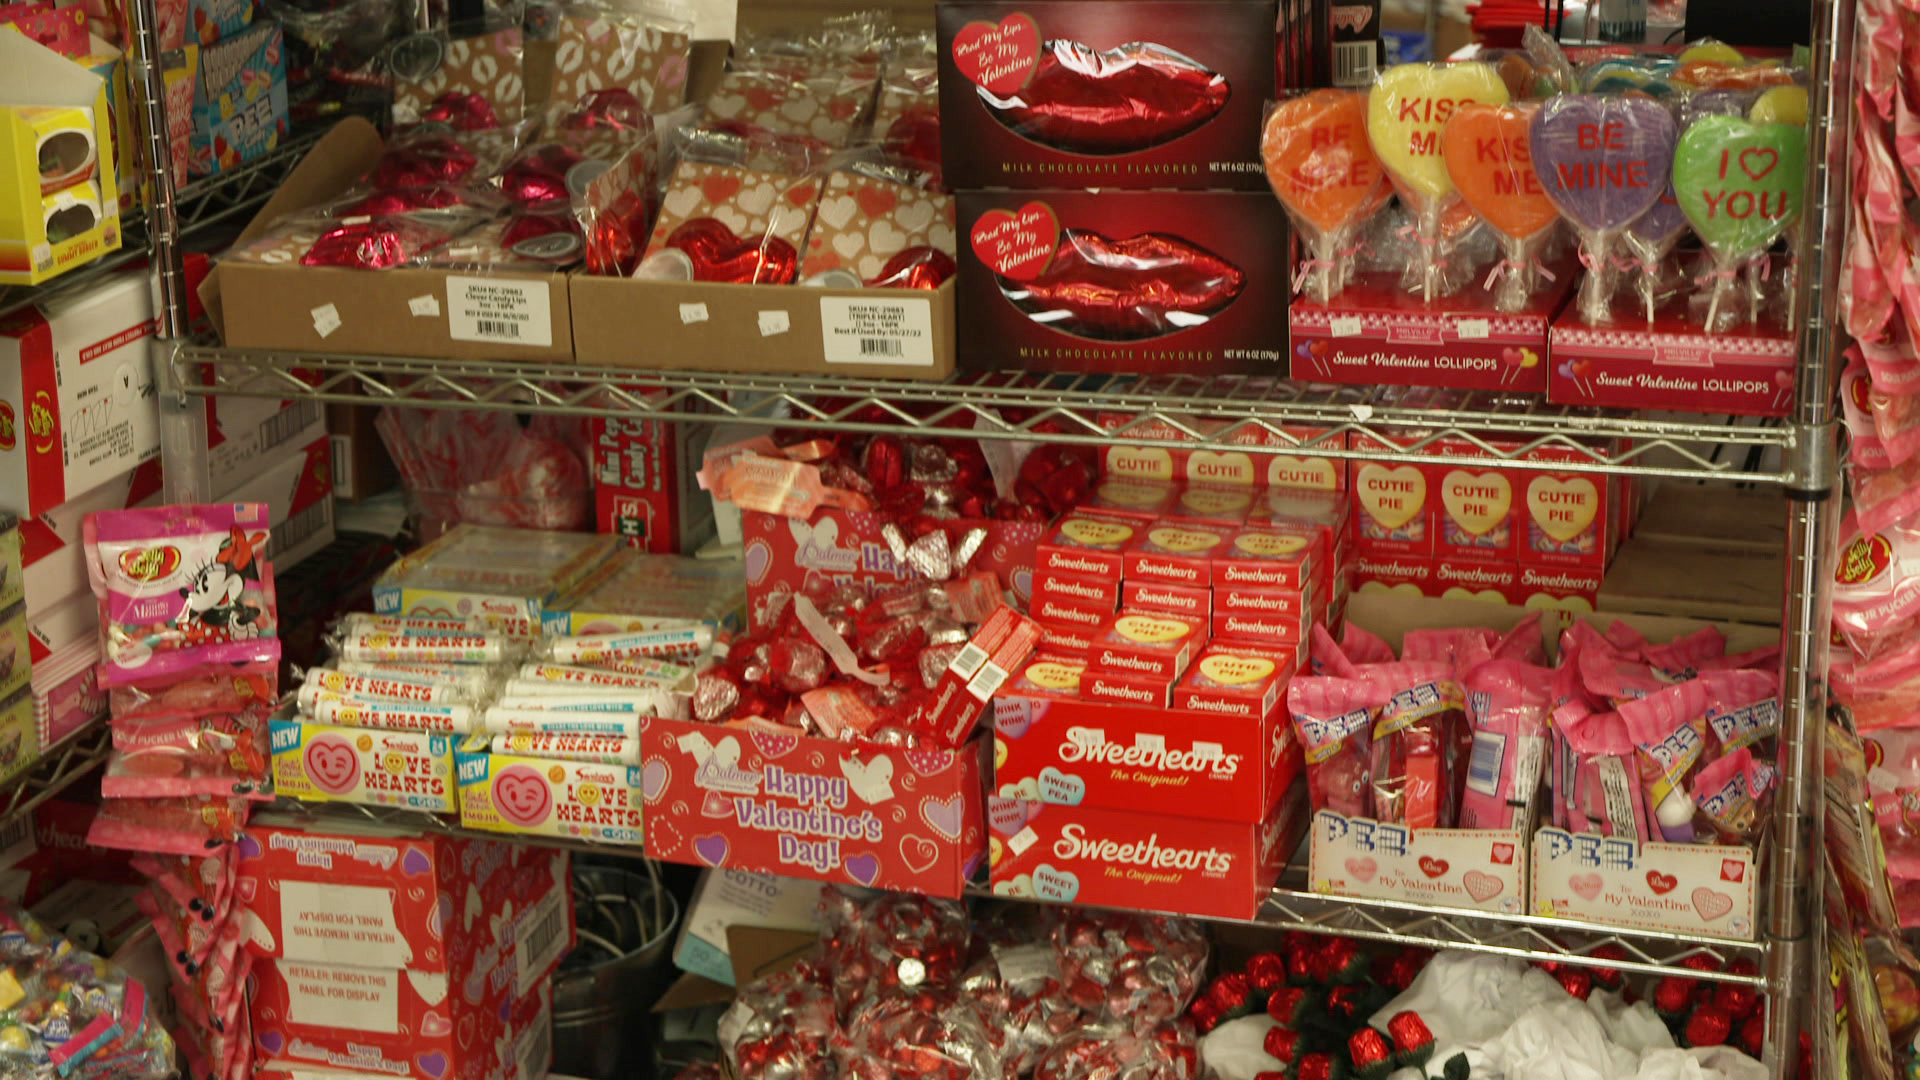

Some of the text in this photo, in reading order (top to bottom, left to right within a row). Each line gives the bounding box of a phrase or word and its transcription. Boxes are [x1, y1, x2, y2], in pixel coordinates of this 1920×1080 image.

[955, 39, 980, 56] Read
[983, 30, 1003, 48] My
[978, 41, 1019, 68] Be My
[977, 55, 1033, 86] Valentine
[1311, 124, 1350, 150] BE
[1410, 131, 1446, 156] M
[1577, 122, 1625, 150] BE
[1002, 162, 1199, 175] MILK CHOCOLATE FLAVORED
[1209, 163, 1220, 172] NET
[1221, 163, 1231, 172] WT
[1236, 163, 1246, 172] OZ
[1719, 149, 1729, 181] I
[1494, 170, 1545, 195] ME
[1557, 160, 1649, 190] MINE
[1702, 190, 1788, 219] YOU
[974, 227, 999, 244] Read
[1001, 219, 1022, 236] My
[996, 230, 1037, 256] Be My
[995, 244, 1051, 273] Valentine
[465, 293, 527, 304] Clever Candy Lips
[858, 328, 876, 336] Used
[1020, 347, 1214, 362] MILK CHOCOLATE FLAVORED
[1224, 350, 1234, 359] NET
[1235, 350, 1245, 360] WT
[1251, 351, 1260, 360] OZ
[1261, 351, 1279, 362] (170g)
[1333, 350, 1497, 371] Sweet Valentine LOLLIPOPS
[123, 375, 129, 389] A
[1596, 371, 1769, 394] Sweet Valentine LOLLIPOPS
[624, 441, 648, 488] Candy
[1117, 457, 1161, 472] CUTIE
[1198, 463, 1242, 478] CUTIE
[1279, 469, 1324, 484] CUTIE
[1368, 478, 1414, 493] CUTIE
[1452, 485, 1499, 500] CUTIE
[1538, 491, 1586, 505] CUTIE
[1378, 497, 1403, 510] PIE
[1463, 503, 1488, 516] PIE
[1549, 509, 1574, 522] PIE
[137, 547, 165, 565] Jelly
[1848, 541, 1872, 564] Jelly
[129, 561, 161, 580] Belly
[1049, 553, 1110, 574] Sweethearts
[1136, 559, 1198, 580] Sweethearts
[1358, 557, 1430, 578] Sweethearts
[1844, 557, 1876, 582] Belly
[1225, 563, 1287, 584] Sweethearts
[1437, 563, 1513, 585] Sweethearts
[1521, 569, 1598, 590] Sweethearts
[1044, 577, 1104, 599] Sweethearts
[375, 592, 400, 611] NEW
[1135, 589, 1197, 608] Sweethearts
[1226, 592, 1288, 611] Sweethearts
[1878, 588, 1916, 617] PUCKER
[133, 602, 169, 619] Minnie
[1042, 602, 1100, 624] Sweethearts
[1225, 617, 1287, 636] Sweethearts
[416, 635, 487, 648] HEARTS
[1100, 652, 1163, 673] Sweethearts
[368, 678, 433, 702] HEARTS
[1092, 680, 1154, 702] Sweethearts
[995, 702, 1022, 716] WINK
[1187, 695, 1250, 714] Sweethearts
[385, 713, 454, 732] HEARTS
[999, 715, 1026, 728] WINK
[138, 731, 176, 745] PUCKER
[271, 727, 299, 749] NEW
[556, 738, 623, 753] HEARTS
[458, 757, 487, 782] NEW
[1110, 769, 1189, 788] The Original!
[364, 771, 445, 795] HEARTS
[764, 765, 848, 809] Happy
[1043, 774, 1080, 793] SWEET
[1013, 787, 1028, 800] BE
[1048, 788, 1070, 803] PEA
[556, 804, 641, 828] HEARTS
[735, 798, 883, 842] Valentine's
[994, 813, 1021, 825] WINK
[1319, 812, 1406, 857] PEZ
[779, 834, 841, 873] Day!
[1053, 824, 1232, 872] Sweethearts
[1540, 830, 1634, 871] PEZ
[1038, 871, 1074, 890] SWEET
[1104, 866, 1182, 885] The Original!
[1008, 884, 1021, 896] BE
[1042, 885, 1063, 899] PEA
[1379, 876, 1397, 889] My
[1402, 878, 1463, 895] Valentine
[1604, 892, 1623, 906] My
[1627, 896, 1691, 912] Valentine
[299, 911, 384, 926] PANEL FOR DISPLAY
[294, 926, 395, 943] RETAILER: REMOVE THIS
[289, 967, 386, 988] RETAILER: REMOVE THIS
[299, 985, 380, 1004] PANEL FOR DISPLAY
